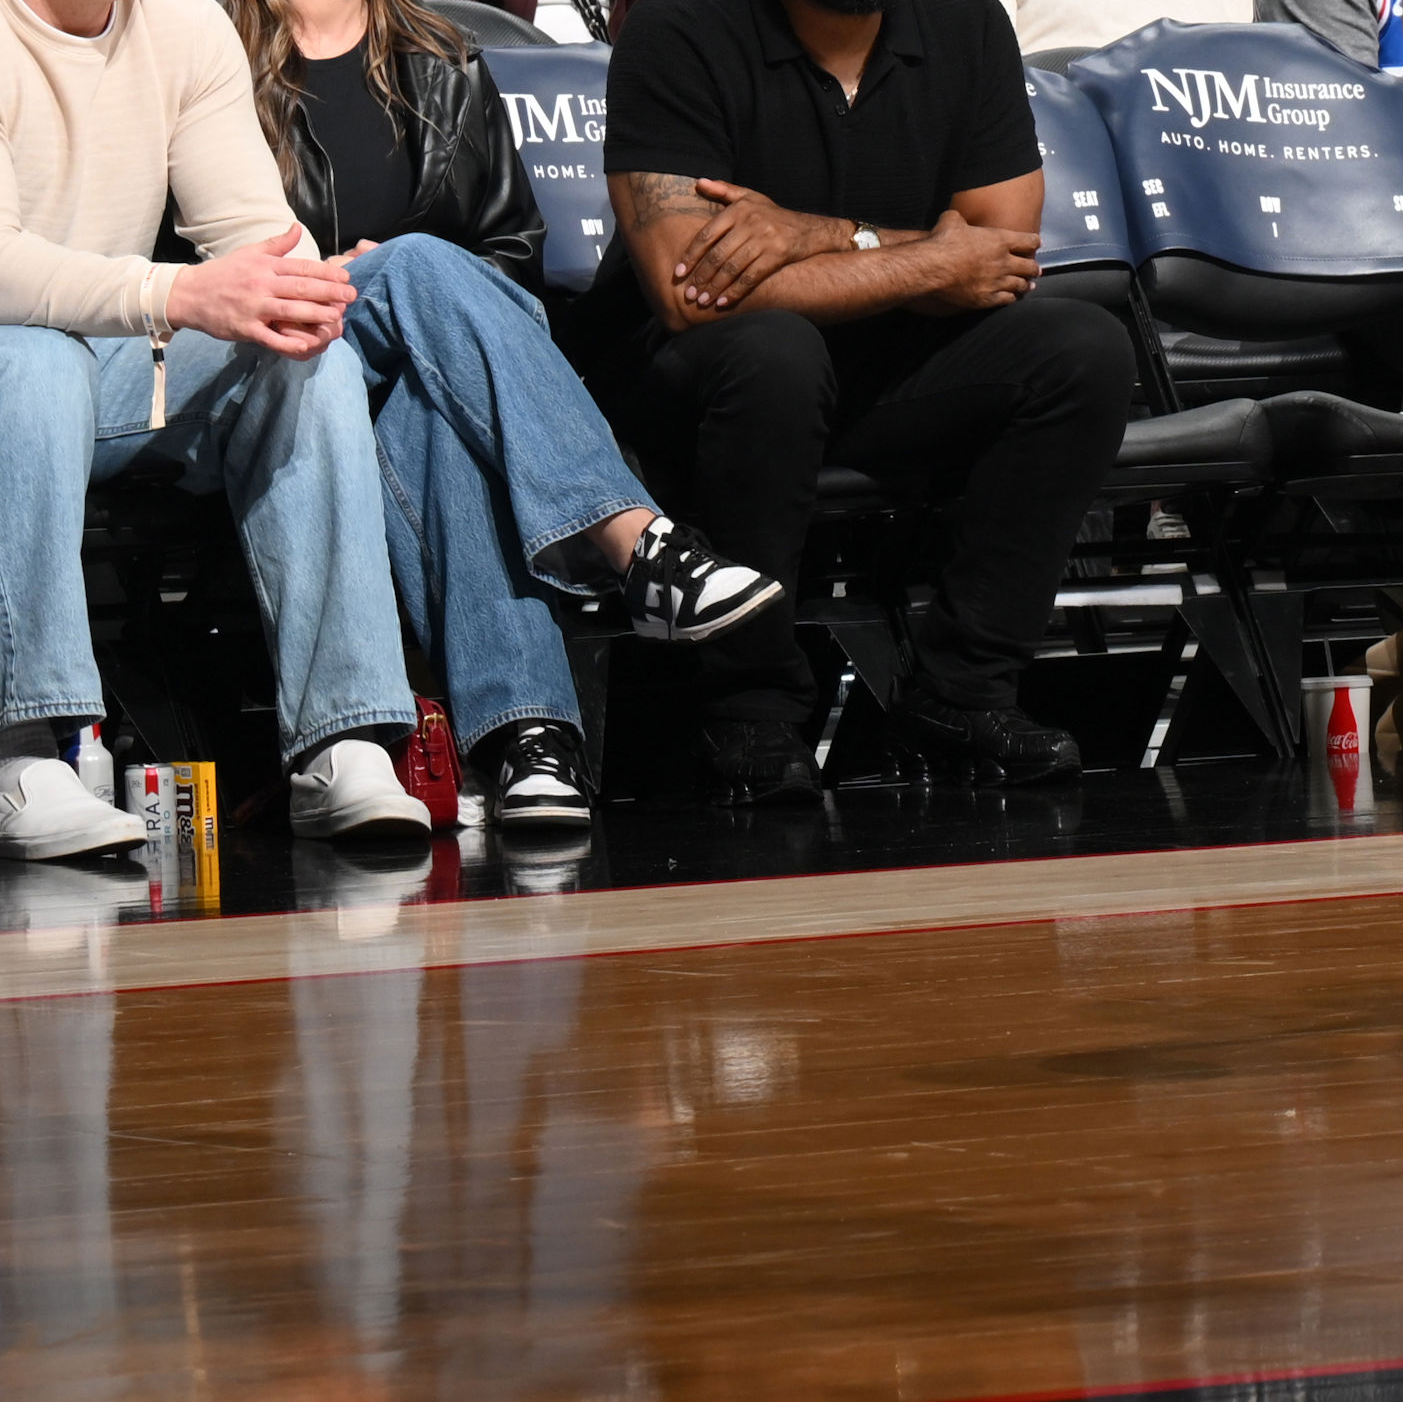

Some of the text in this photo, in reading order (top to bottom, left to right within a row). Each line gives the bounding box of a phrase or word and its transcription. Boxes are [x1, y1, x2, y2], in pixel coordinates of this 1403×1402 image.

[1141, 68, 1365, 128] NJM Insurance
[1266, 103, 1331, 131] Group
[1161, 131, 1379, 160] AUTO. HOME. RENTERS.
[533, 164, 595, 179] HOME.
[1142, 178, 1165, 196] SEC
[1072, 190, 1099, 208] SEAT
